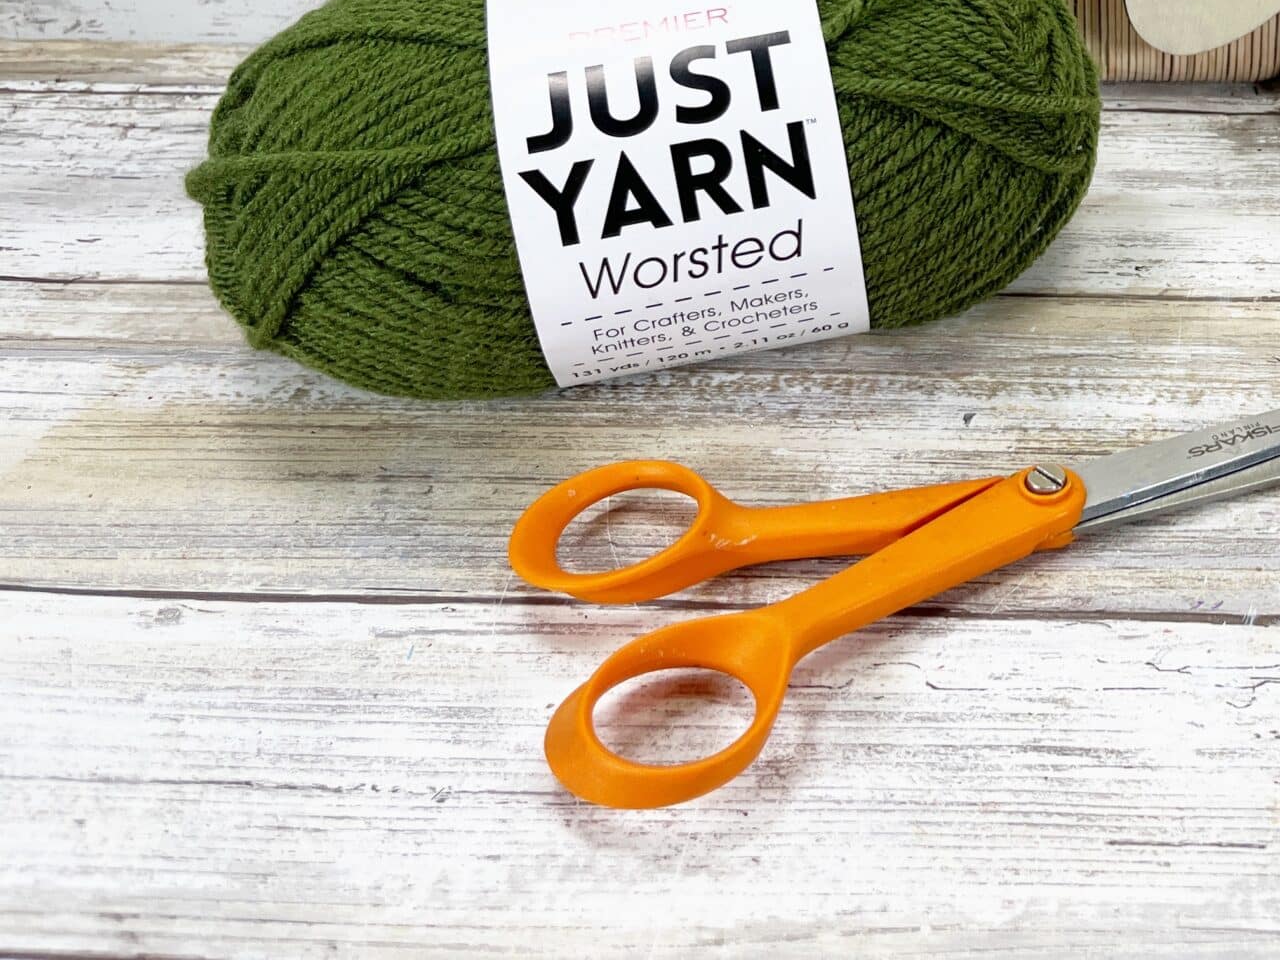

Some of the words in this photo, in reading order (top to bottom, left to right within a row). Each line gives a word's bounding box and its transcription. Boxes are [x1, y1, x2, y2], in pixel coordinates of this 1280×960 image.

[525, 30, 792, 155] JUST
[517, 120, 817, 247] YARN
[579, 218, 803, 299] Worsted
[591, 332, 673, 355] Knitters,
[681, 325, 697, 337] &
[704, 300, 819, 333] Crocheters
[593, 326, 626, 341] For
[633, 307, 722, 332] Crafters,
[730, 288, 809, 312] Makers,
[1211, 421, 1262, 440] FINLAND
